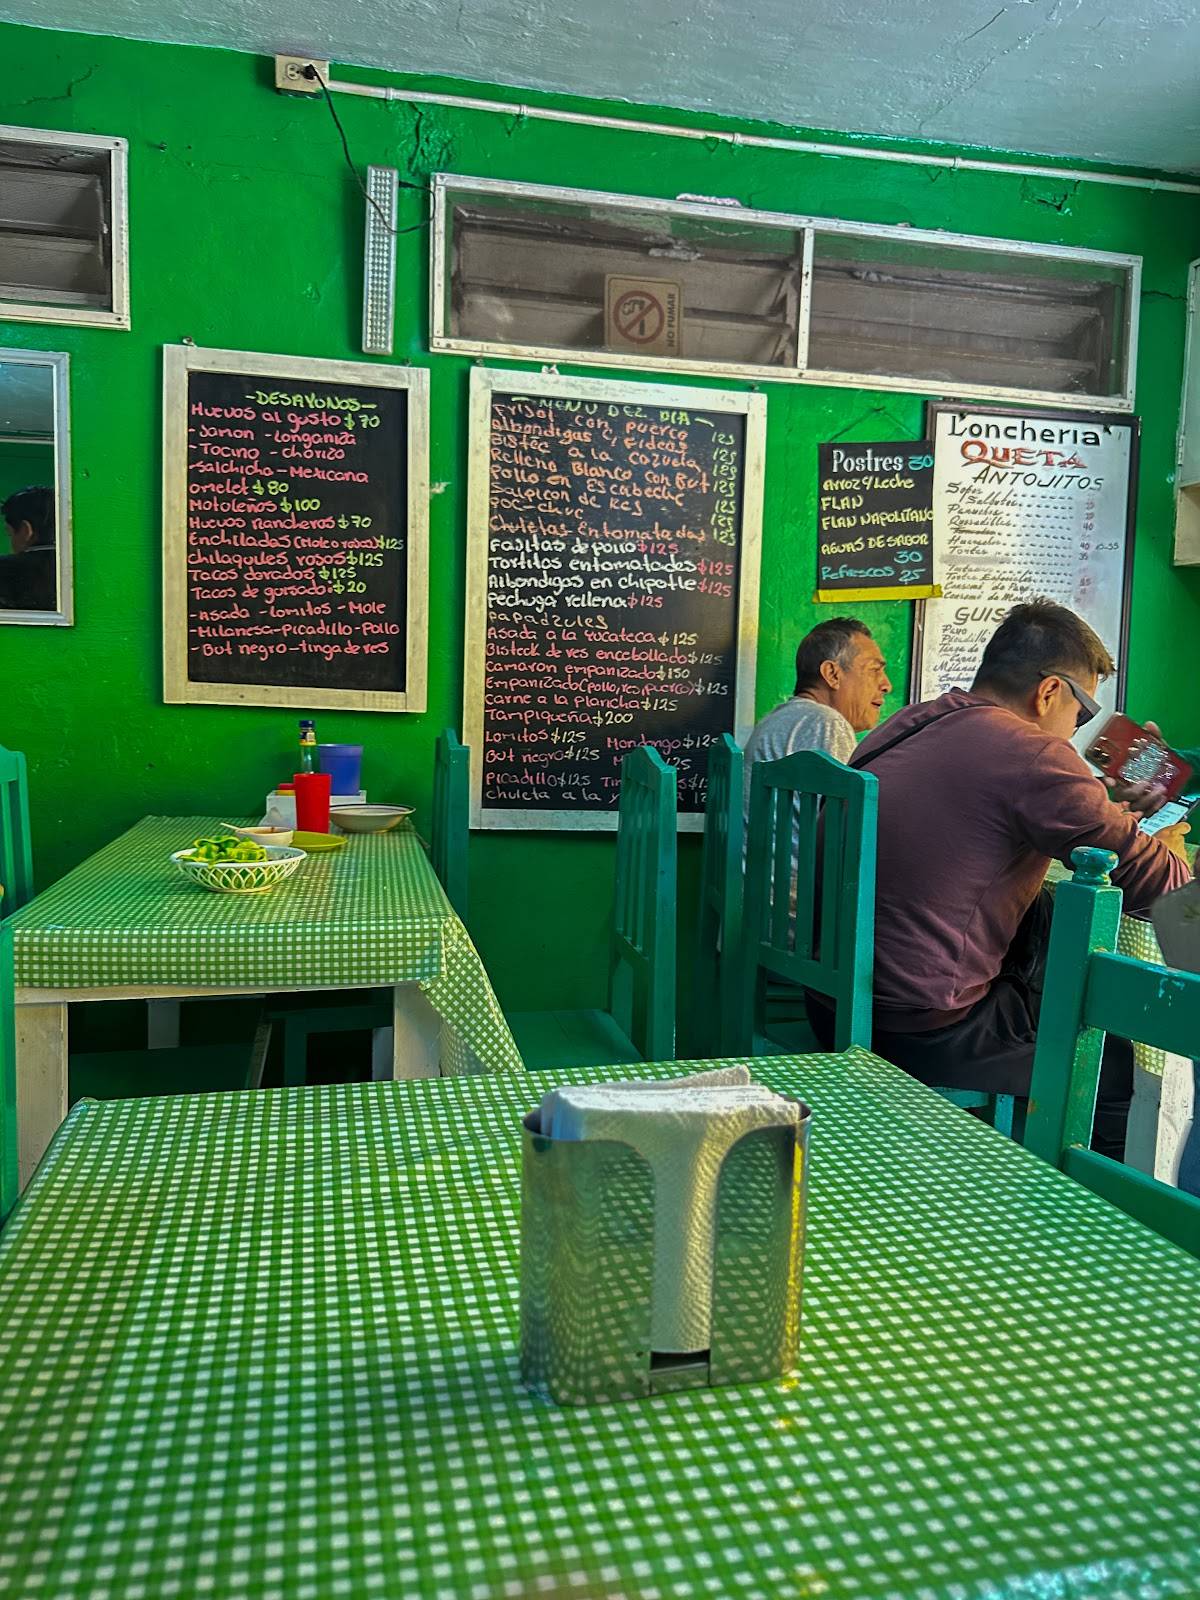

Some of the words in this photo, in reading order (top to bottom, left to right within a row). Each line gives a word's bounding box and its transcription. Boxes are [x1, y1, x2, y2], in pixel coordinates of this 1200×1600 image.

[191, 402, 256, 420] Huevos
[262, 412, 282, 424] al
[287, 412, 341, 433] gusto
[947, 415, 1101, 447] Loncheria
[568, 446, 585, 459] a
[591, 447, 613, 462] la
[831, 447, 903, 473] Postres
[960, 439, 1088, 470] QUETA
[489, 465, 540, 484] Pollo
[571, 460, 632, 481] Blanco
[972, 465, 1105, 491] ANTOJITOS
[820, 494, 864, 511] FLAN
[189, 516, 247, 529] Huevos
[189, 530, 291, 549] Enchiladas
[867, 534, 886, 550] DE
[346, 552, 384, 567] $125
[893, 550, 923, 565] 30
[188, 569, 238, 582] Tacos
[244, 564, 315, 582] dorados
[318, 566, 357, 581] $125
[697, 559, 734, 577] $125
[191, 587, 237, 600] Tacos
[241, 584, 260, 599] de
[590, 577, 613, 589] en
[697, 579, 733, 598] $125
[565, 592, 628, 609] rellena
[628, 593, 665, 609] $125
[487, 624, 537, 641] Asada
[546, 629, 557, 641] a
[561, 628, 577, 641] la
[239, 643, 287, 661] negro
[362, 641, 390, 655] res
[545, 643, 563, 658] de
[566, 647, 589, 660] res
[688, 649, 724, 666] $125
[537, 695, 548, 705] a
[553, 693, 569, 706] la
[641, 697, 679, 712] $125
[592, 711, 634, 728] $200
[485, 728, 549, 744] Lomitos
[551, 728, 587, 745] $125
[522, 751, 564, 768] negro
[564, 746, 600, 763] $125
[557, 771, 592, 787] $125
[562, 791, 576, 800] a
[582, 789, 601, 801] la
